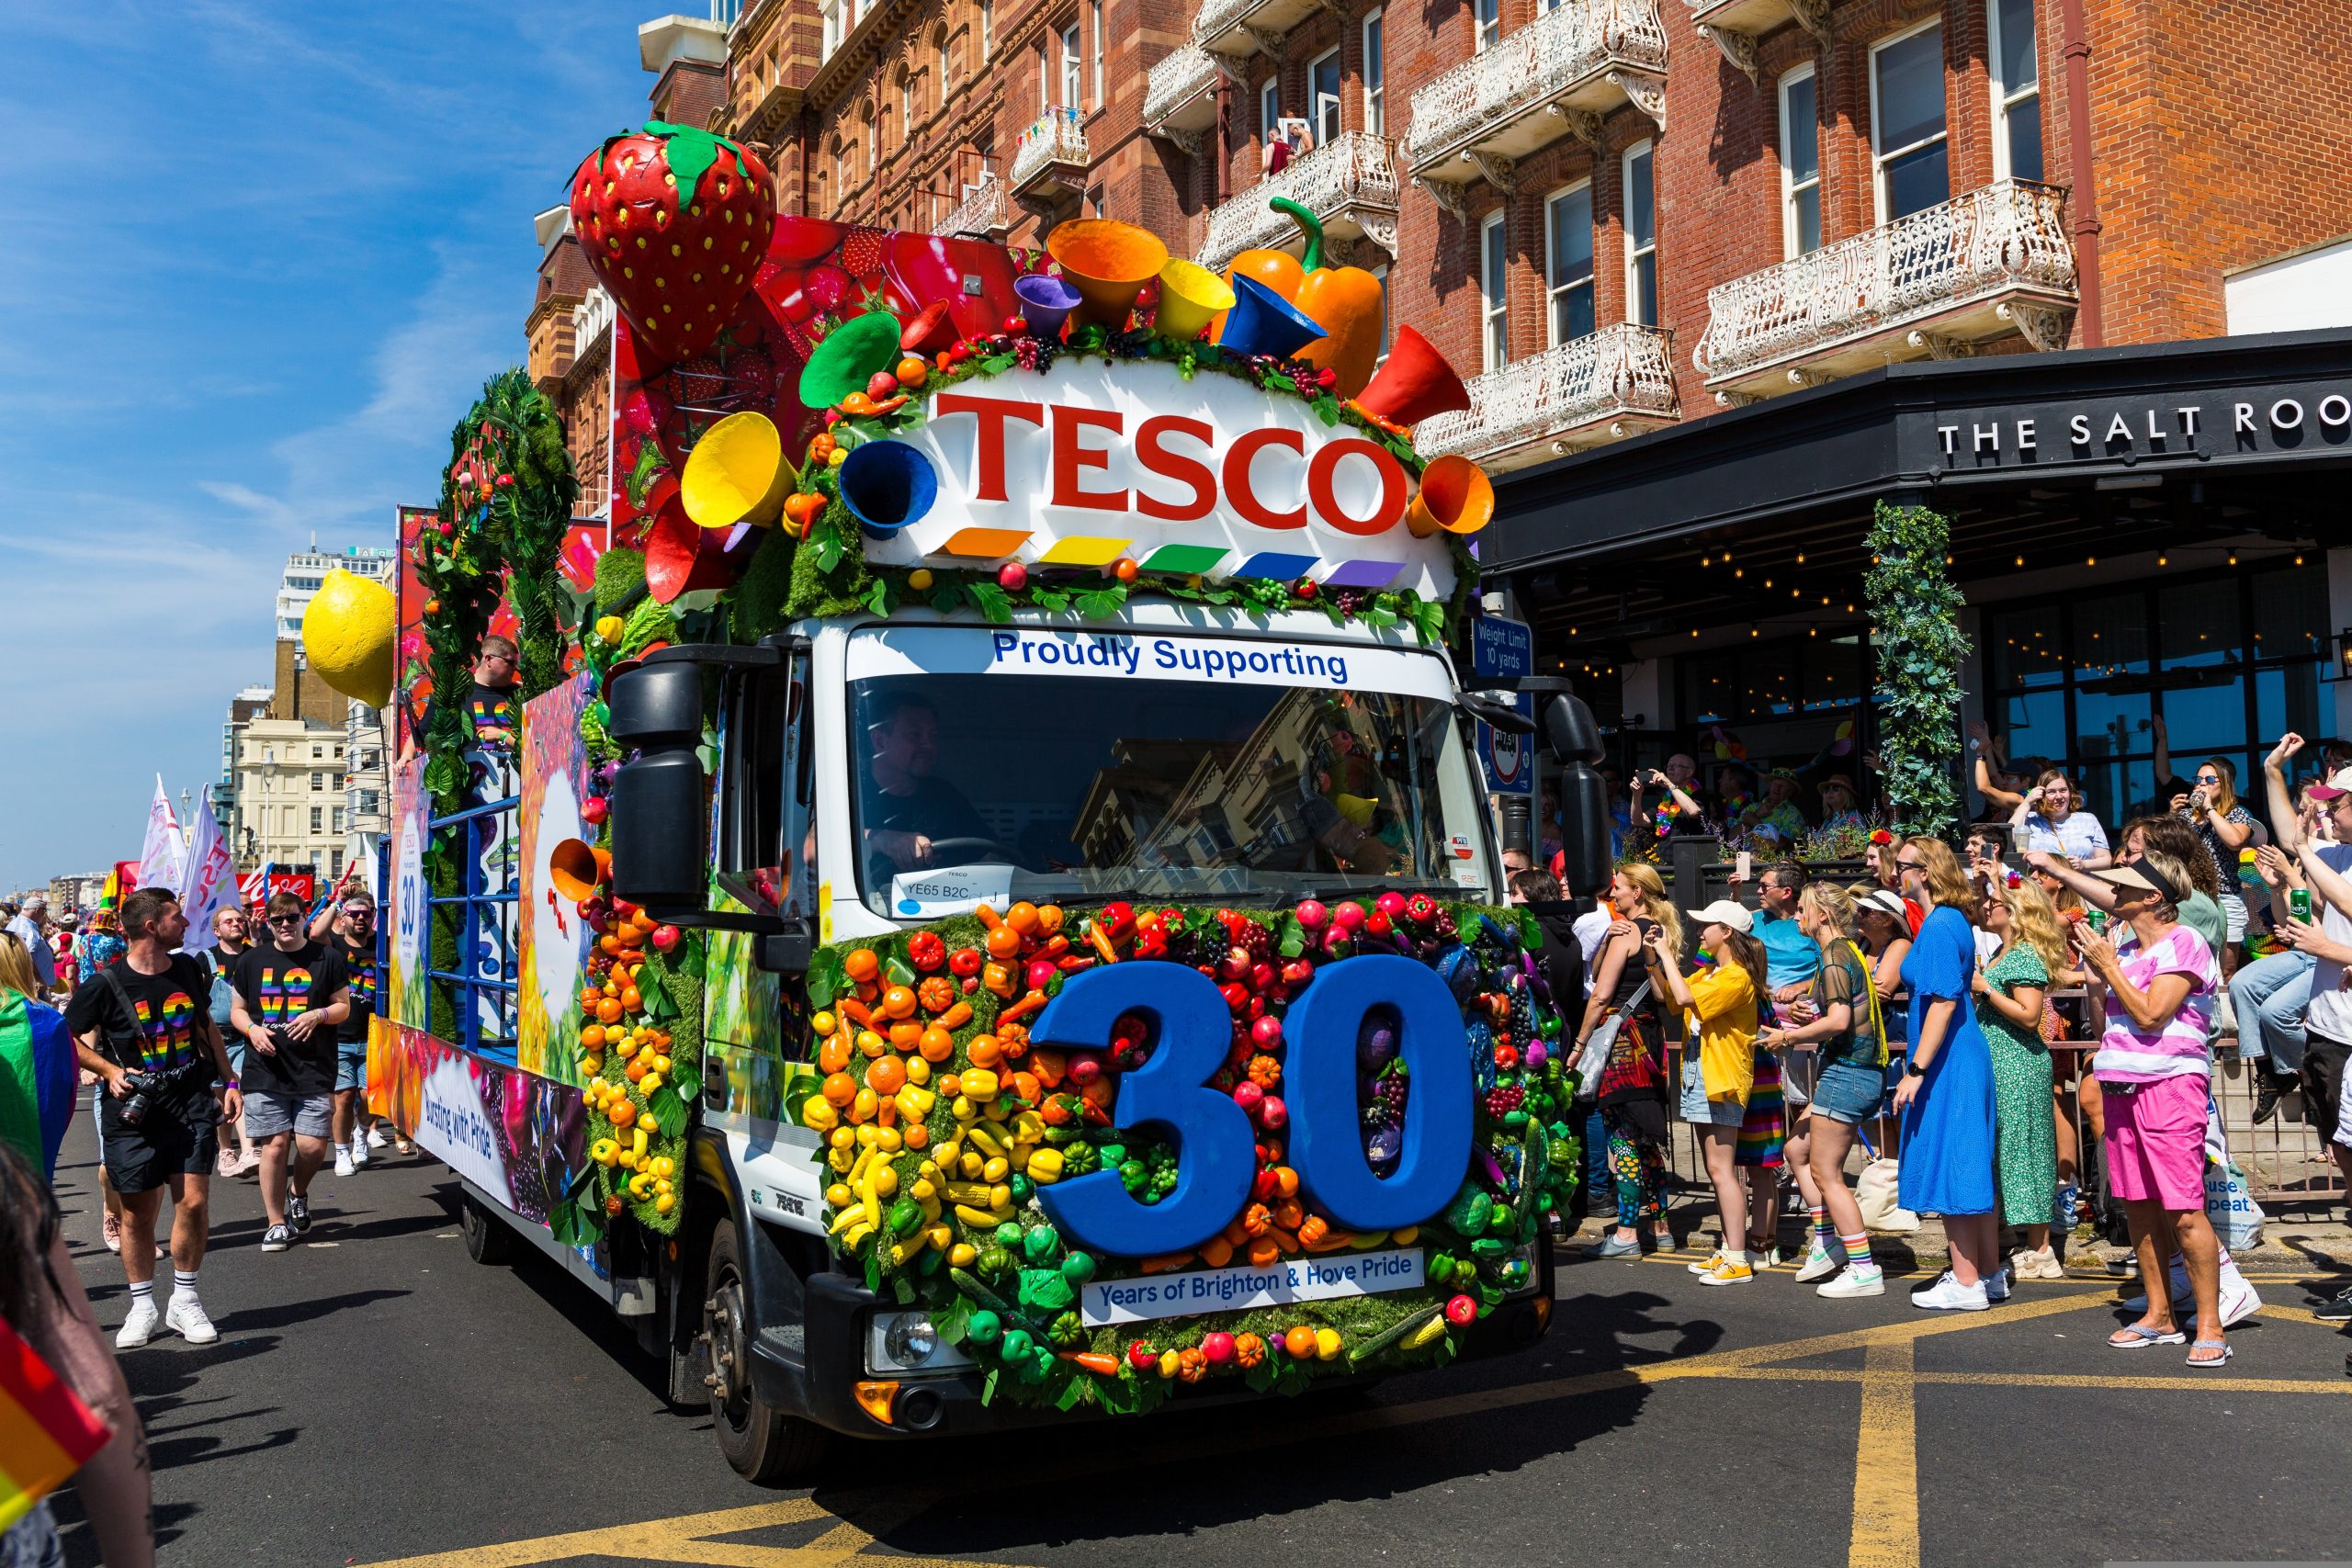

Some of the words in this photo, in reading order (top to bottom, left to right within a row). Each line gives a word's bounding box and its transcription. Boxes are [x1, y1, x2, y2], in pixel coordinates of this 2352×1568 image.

[1938, 419, 2036, 455] THE
[2070, 406, 2200, 445] SALT
[2234, 394, 2352, 433] ROO
[937, 393, 1408, 536] TESCO
[993, 633, 1141, 675] Proudly
[1153, 639, 1349, 684] Supporting
[1478, 624, 1506, 646] Weight
[1509, 630, 1527, 649] Limit
[1487, 647, 1496, 664] 10
[1498, 653, 1521, 670] yards
[401, 874, 414, 936] 30
[909, 883, 939, 897] YE65
[943, 886, 969, 899] B2C
[261, 967, 312, 994] LO
[134, 991, 195, 1035] LO
[259, 996, 309, 1022] VE
[137, 1029, 191, 1072] VE
[1029, 953, 1474, 1257] 30
[452, 1104, 470, 1146] with
[470, 1111, 492, 1160] Pride
[1100, 1284, 1158, 1308] Years
[1164, 1281, 1185, 1301] of
[1192, 1272, 1279, 1301] Brighton
[1286, 1268, 1301, 1287] &
[1307, 1265, 1356, 1285] Hove
[1363, 1256, 1412, 1280] Pride
